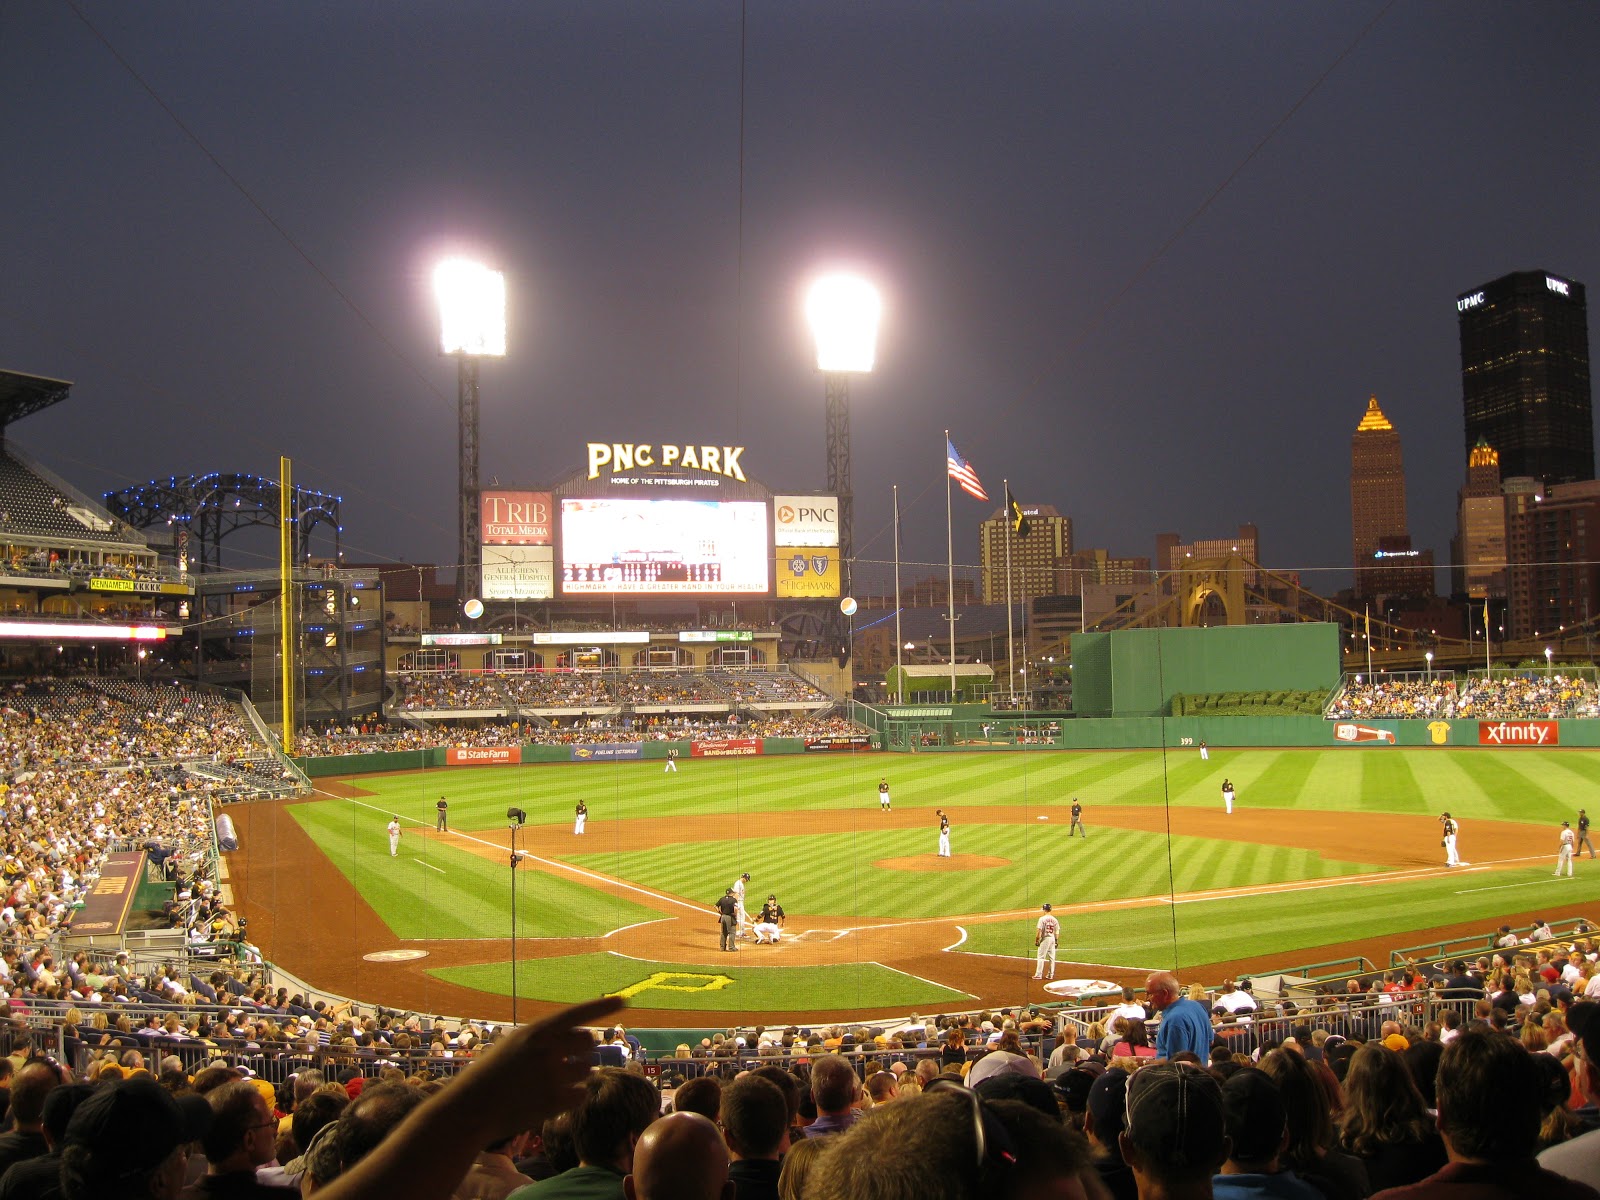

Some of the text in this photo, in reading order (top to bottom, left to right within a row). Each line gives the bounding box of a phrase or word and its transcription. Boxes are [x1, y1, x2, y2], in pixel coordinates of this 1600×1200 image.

[1546, 276, 1569, 296] UPMC
[1457, 292, 1484, 311] UPMC
[587, 443, 746, 482] PNC PARK
[485, 498, 547, 523] TRIB
[798, 508, 834, 522] PNC
[486, 524, 548, 535] TOTAL MEDIA
[564, 568, 601, 580] 2 2 1
[92, 580, 132, 589] KENNAMETAL
[786, 581, 834, 590] HIGHMARK
[1488, 722, 1548, 743] xfinity
